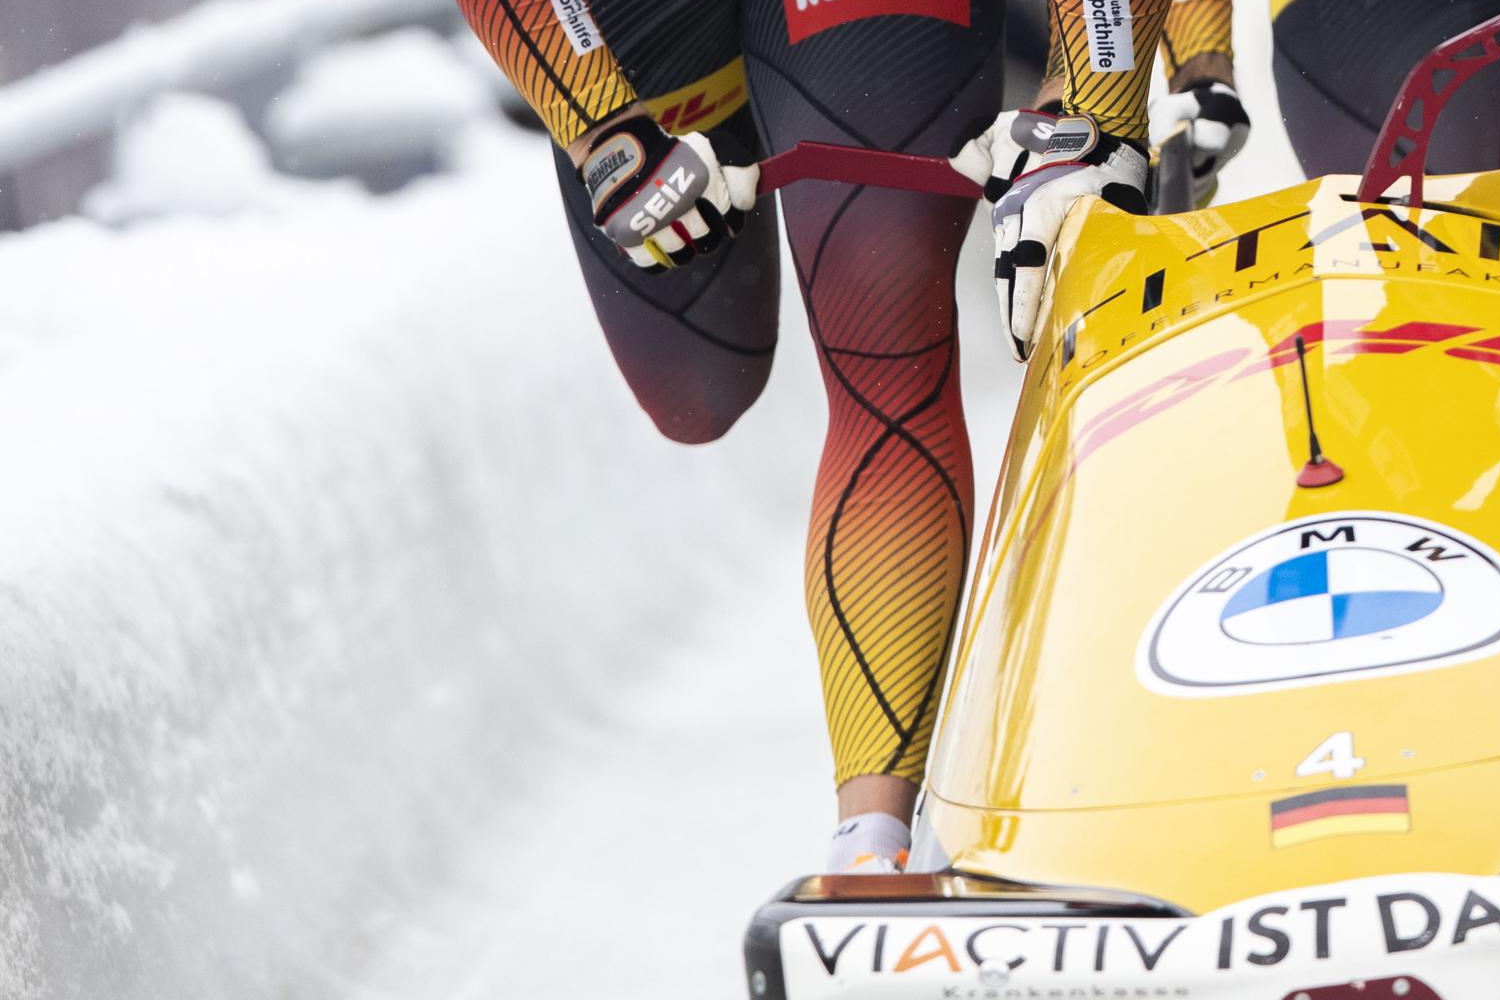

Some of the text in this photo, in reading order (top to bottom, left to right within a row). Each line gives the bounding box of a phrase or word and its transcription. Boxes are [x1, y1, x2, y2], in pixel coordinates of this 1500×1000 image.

[1198, 526, 1466, 594] BMW
[1296, 731, 1365, 778] 4
[803, 923, 1188, 975] VIACTIV
[1217, 899, 1347, 970] IST
